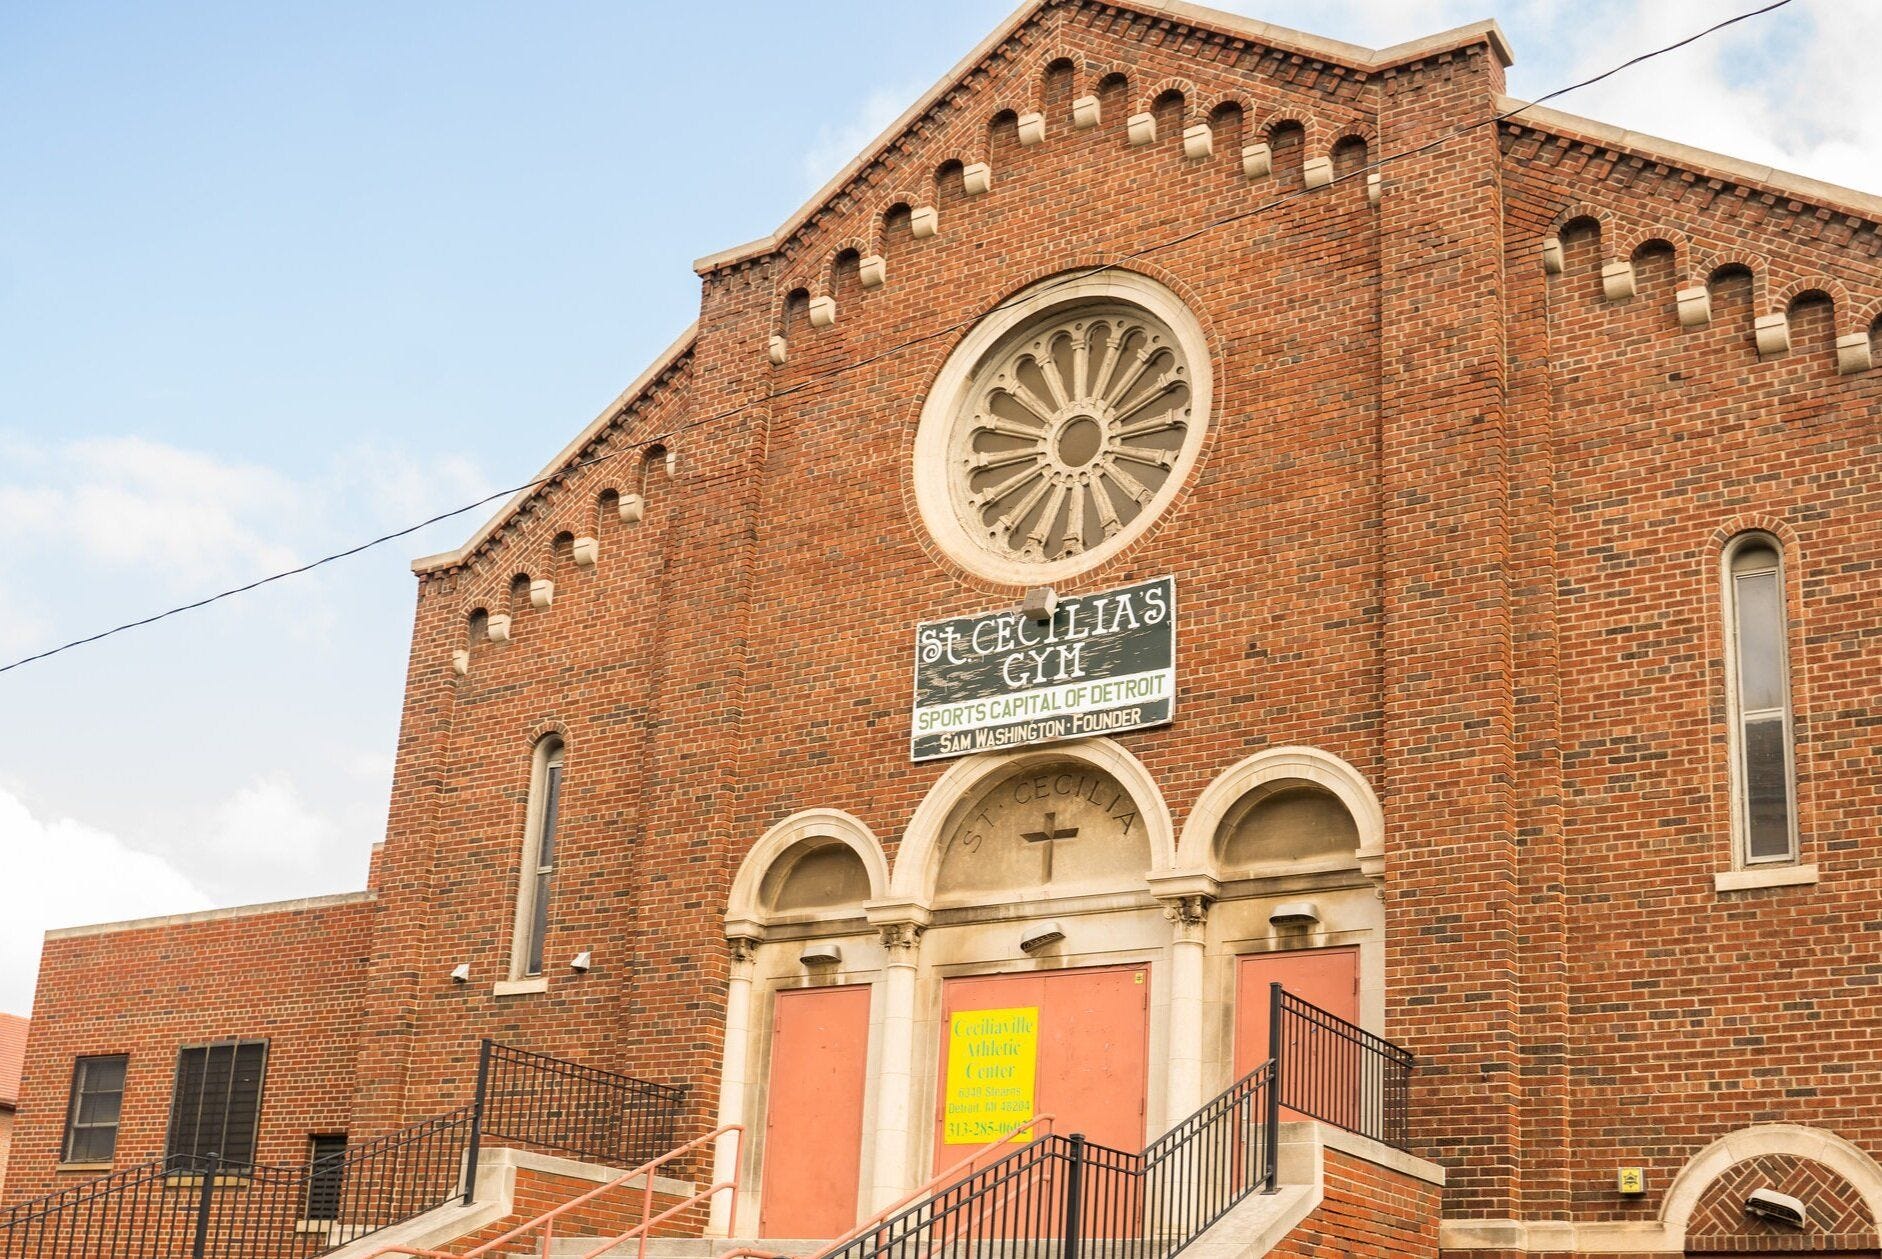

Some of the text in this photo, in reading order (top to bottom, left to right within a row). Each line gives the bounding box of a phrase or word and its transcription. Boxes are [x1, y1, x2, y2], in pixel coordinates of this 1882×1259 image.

[921, 587, 1167, 665] St. CECILIA'S
[1003, 643, 1086, 687] GYM
[918, 674, 1167, 731] SPORTS CAPITAL OF DETROIT
[940, 708, 1142, 754] SAM WASHINGTON FOUNDER
[1014, 774, 1136, 836] CECILIA
[954, 1016, 1033, 1037] Ceciliaville
[968, 1038, 1021, 1057] Athletic
[966, 1062, 1016, 1079] Center
[985, 1102, 997, 1113] MI
